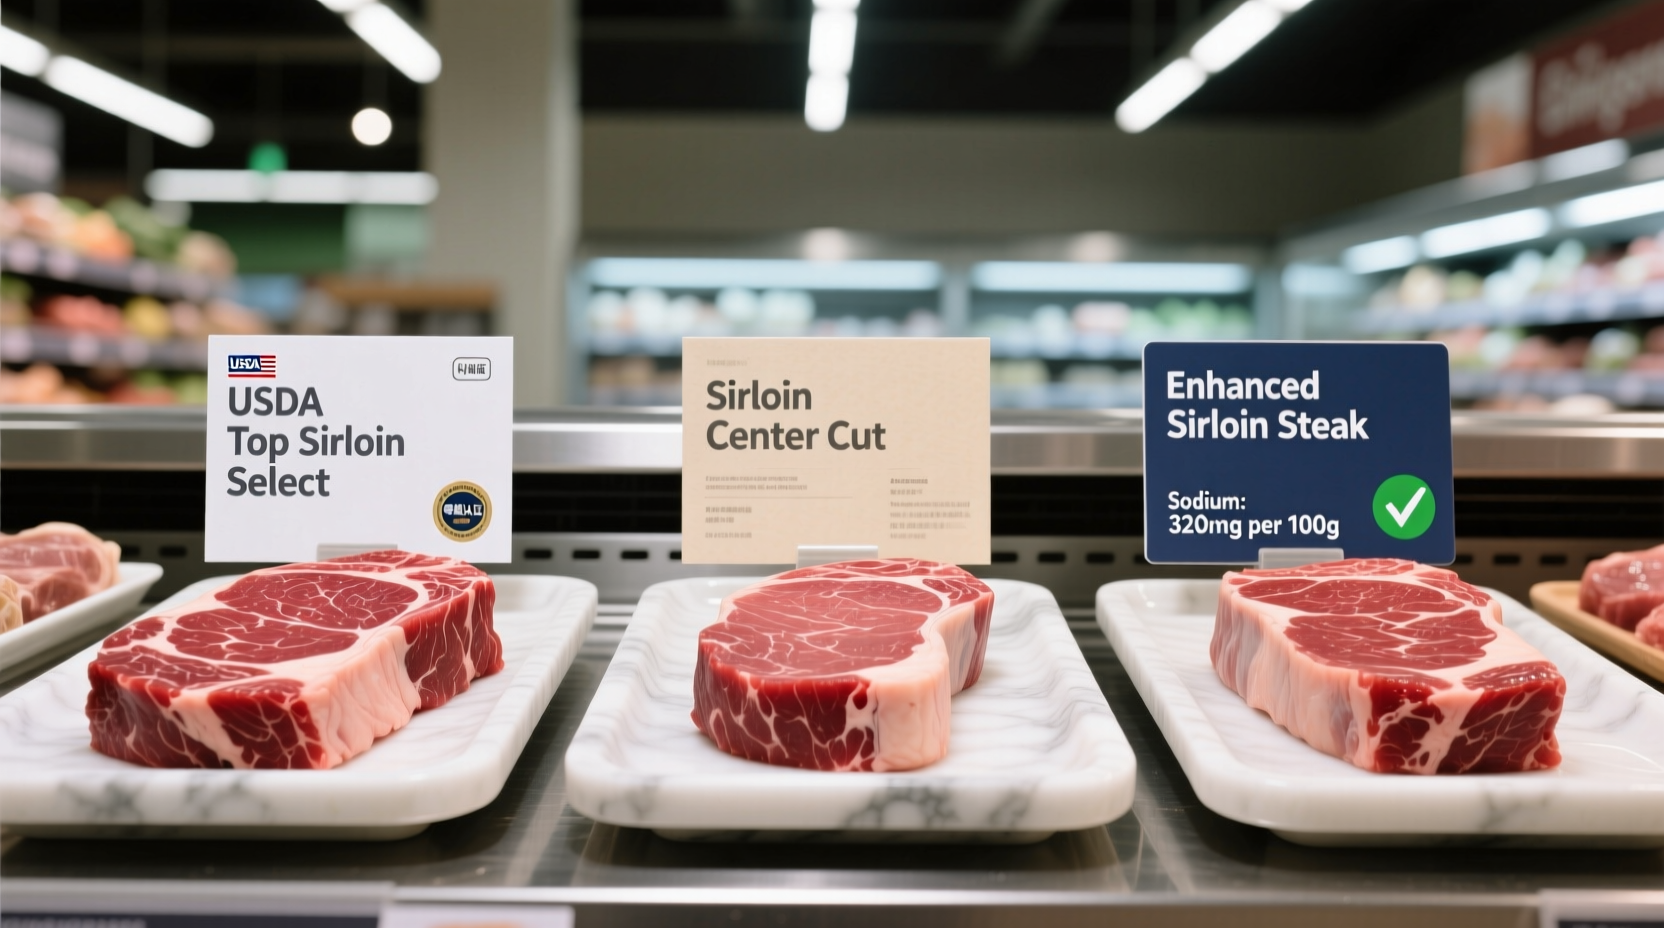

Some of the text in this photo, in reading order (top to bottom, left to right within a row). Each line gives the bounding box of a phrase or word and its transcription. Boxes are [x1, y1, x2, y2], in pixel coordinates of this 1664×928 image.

[706, 379, 811, 410] Sirloin
[1167, 370, 1320, 400] Enhanced
[228, 386, 324, 417] USDA
[706, 419, 886, 451] Center Cut
[1167, 408, 1370, 440] Sirloin Steak
[226, 424, 405, 463] Top Sirloin
[226, 466, 331, 497] Select
[1167, 490, 1247, 510] Sodium:
[1168, 514, 1340, 540] 320mg per 100g
